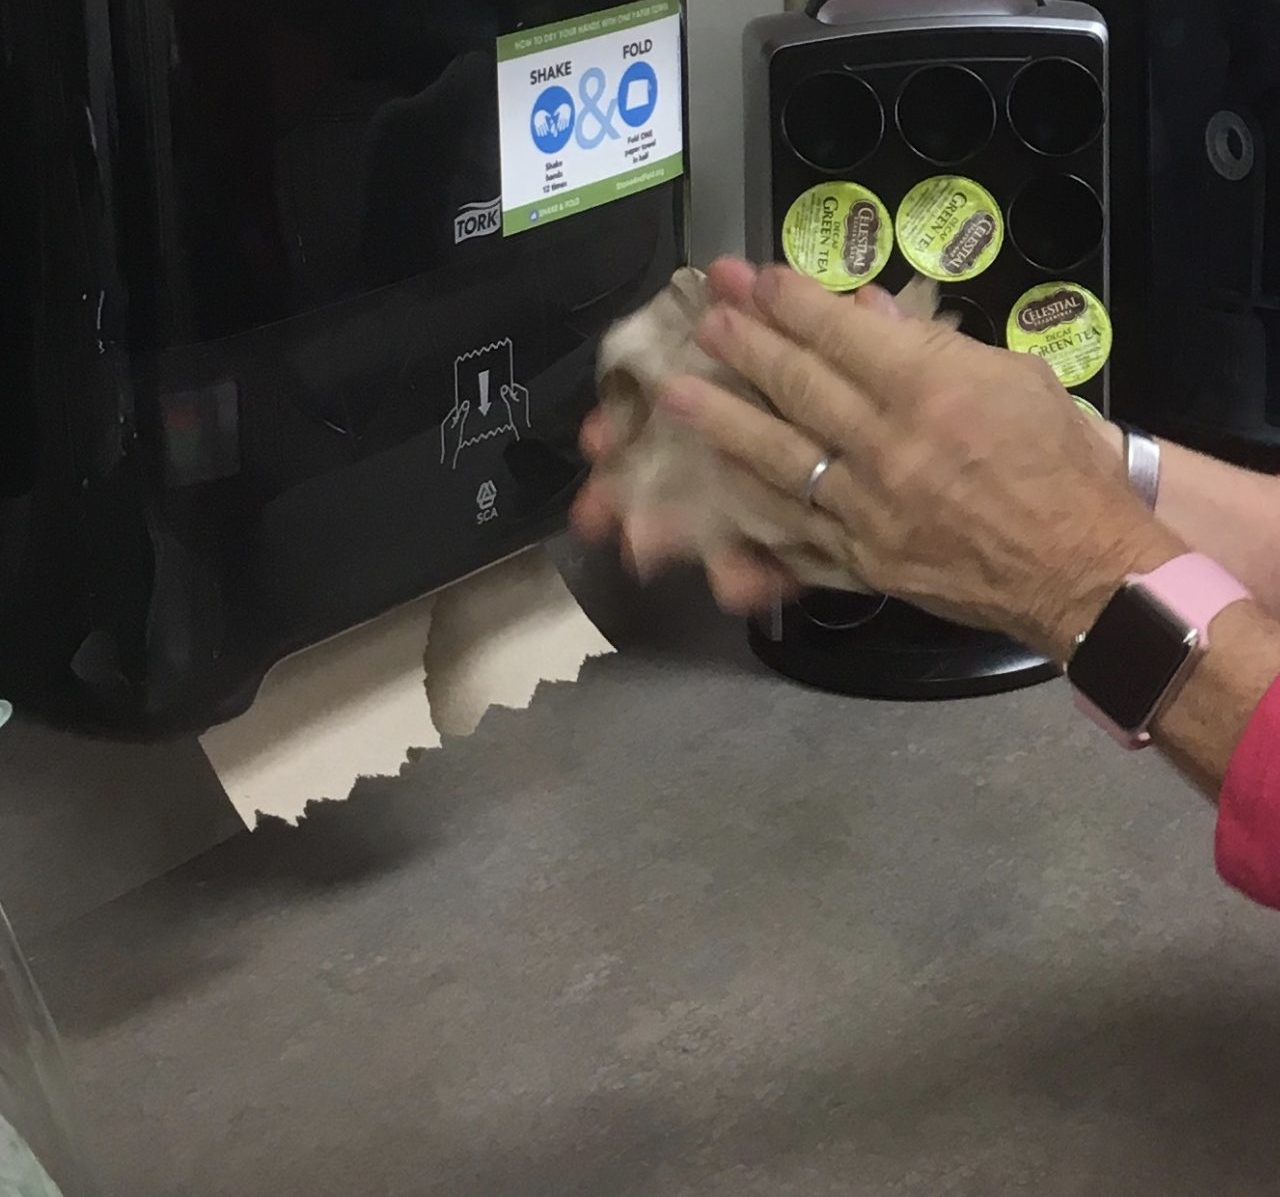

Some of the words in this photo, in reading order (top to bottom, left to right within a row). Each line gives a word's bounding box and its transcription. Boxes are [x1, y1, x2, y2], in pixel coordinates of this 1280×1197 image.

[530, 61, 572, 85] SHAKE
[623, 39, 653, 59] FOLD
[456, 208, 498, 238] TORK
[820, 196, 839, 246] GREEN
[931, 192, 968, 234] GREEN
[853, 207, 875, 267] CELESTIAL
[947, 219, 992, 268] CELESTIAL
[817, 249, 830, 274] TEA
[1022, 296, 1081, 325] CELESTIAL
[1028, 338, 1073, 356] GREEN
[1075, 326, 1101, 342] TEA
[1045, 327, 1072, 342] DECAF
[476, 507, 499, 524] SCA
